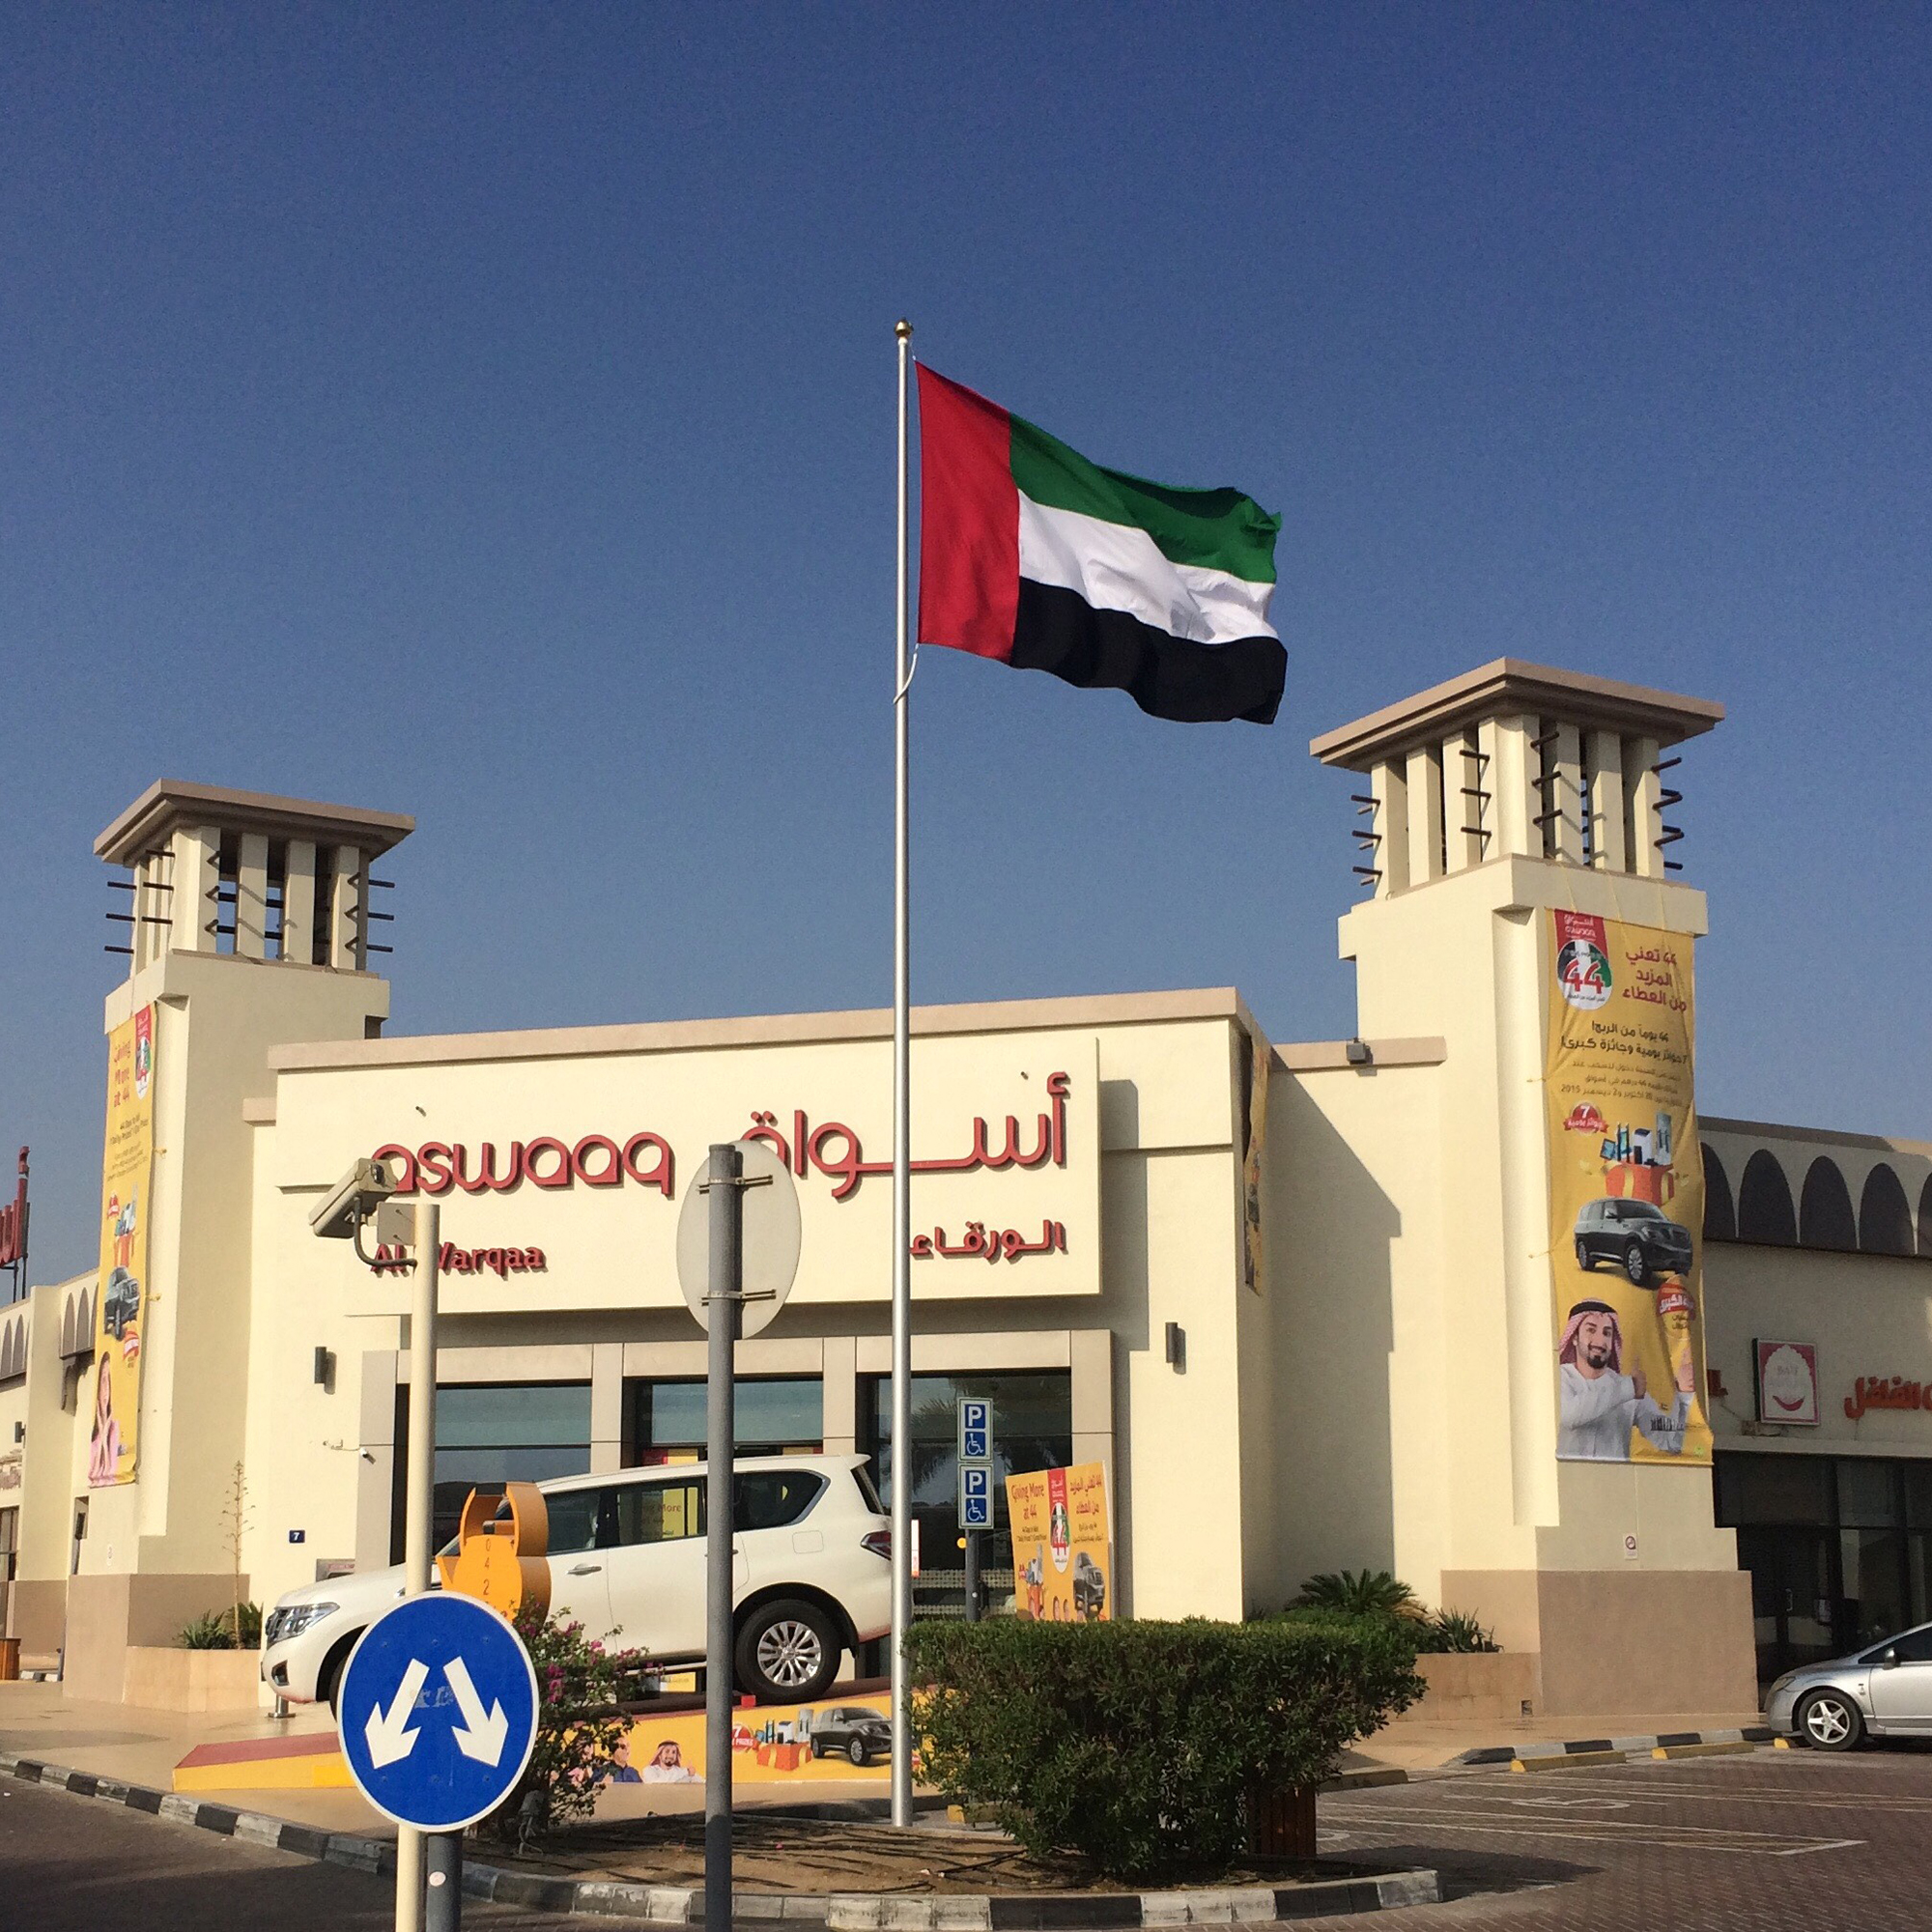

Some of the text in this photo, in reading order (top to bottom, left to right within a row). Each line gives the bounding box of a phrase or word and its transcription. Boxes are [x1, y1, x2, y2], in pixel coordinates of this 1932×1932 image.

[1626, 946, 1661, 965] تعني
[1563, 958, 1605, 994] 44
[1635, 968, 1672, 987] المزيد
[1622, 985, 1688, 1012] من العطاء
[1620, 1026, 1635, 1037] من
[1600, 1037, 1634, 1054] وجائزة
[1561, 1084, 1581, 1094] 2015
[1580, 1105, 1590, 1119] 7
[372, 1131, 670, 1196] aswaaq
[909, 1219, 1064, 1260] الورقاء
[968, 1406, 982, 1427] P
[968, 1472, 983, 1493] P
